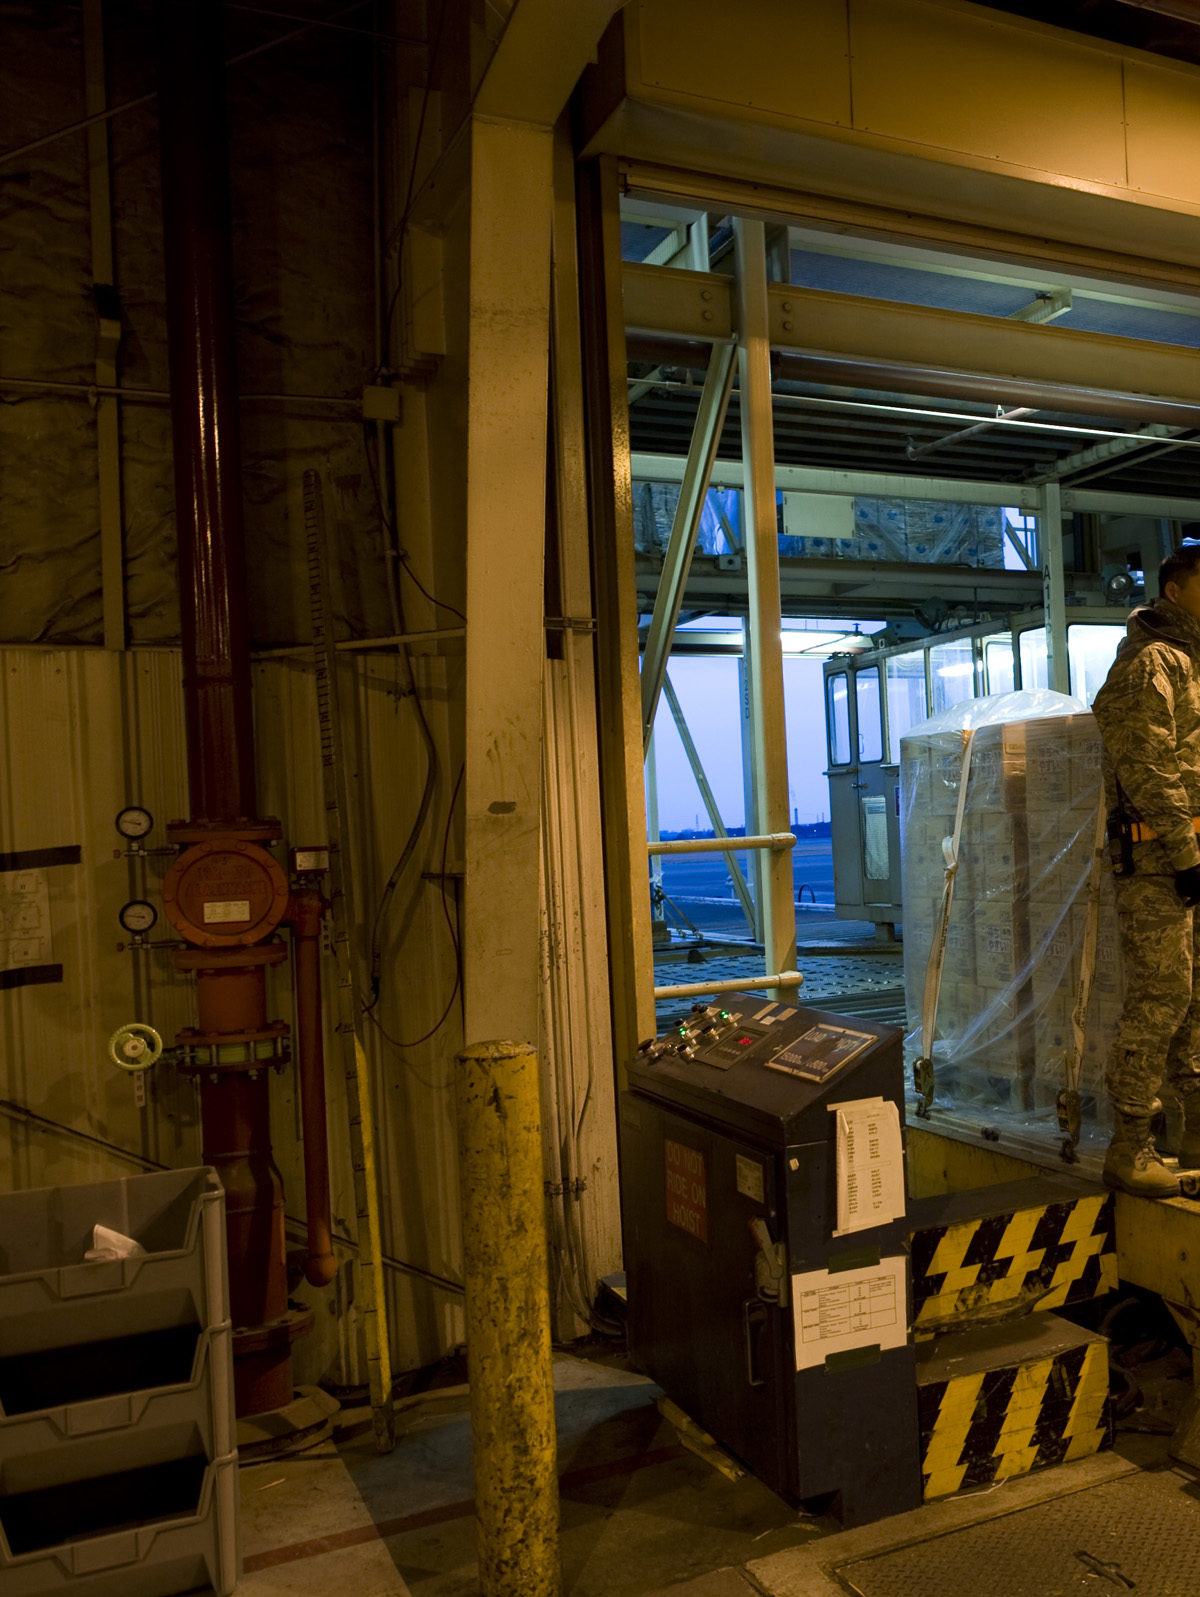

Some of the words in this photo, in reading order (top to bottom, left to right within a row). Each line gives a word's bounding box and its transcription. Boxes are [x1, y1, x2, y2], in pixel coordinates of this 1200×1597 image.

[668, 1141, 681, 1166] DO
[683, 1149, 704, 1177] NOT
[667, 1170, 688, 1199] RIDE
[691, 1182, 706, 1209] ON
[673, 1201, 701, 1235] HOIST
